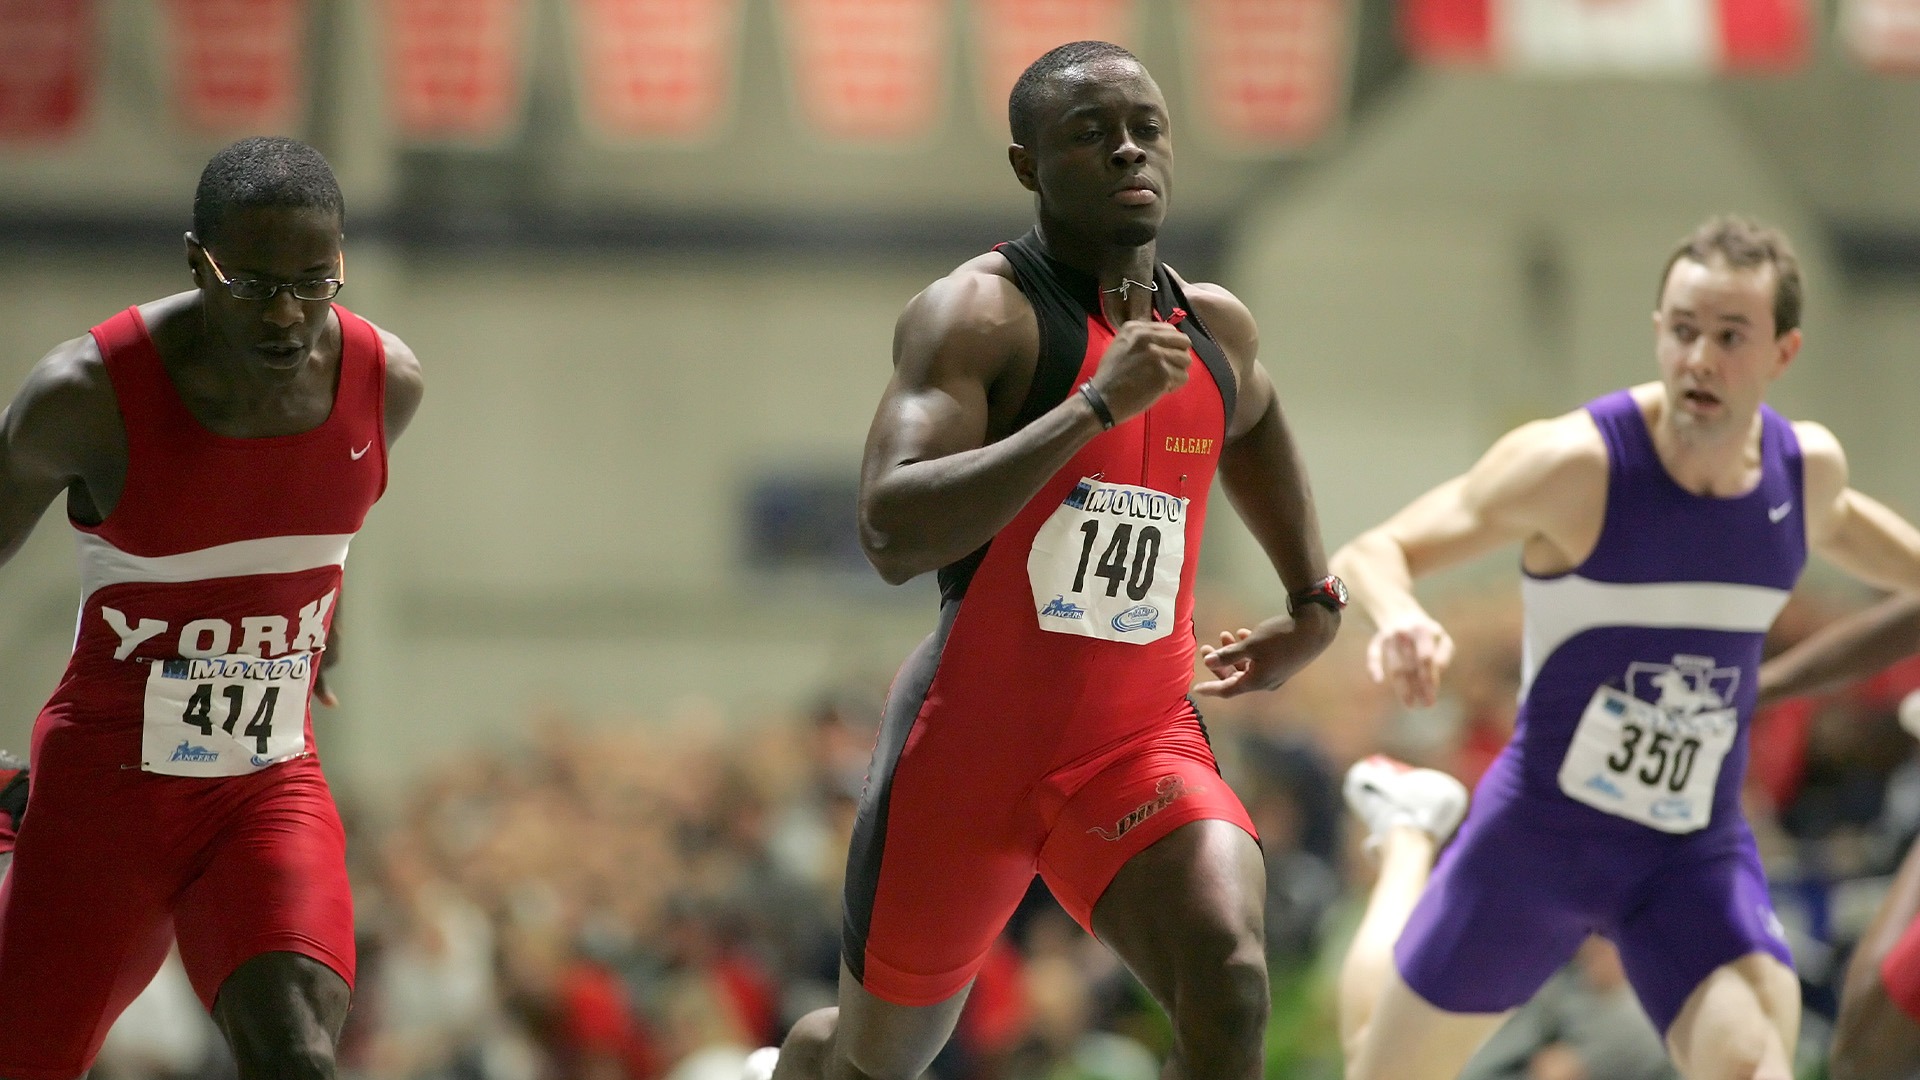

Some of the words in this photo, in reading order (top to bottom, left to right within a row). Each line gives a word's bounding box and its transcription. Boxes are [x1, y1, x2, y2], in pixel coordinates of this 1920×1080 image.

[1165, 436, 1214, 454] CALGARY
[1085, 488, 1182, 522] MONDO
[1071, 519, 1162, 601] 140
[101, 587, 337, 662] YORK
[190, 656, 308, 680] MONDO
[182, 683, 281, 754] 414
[1607, 724, 1702, 792] 350
